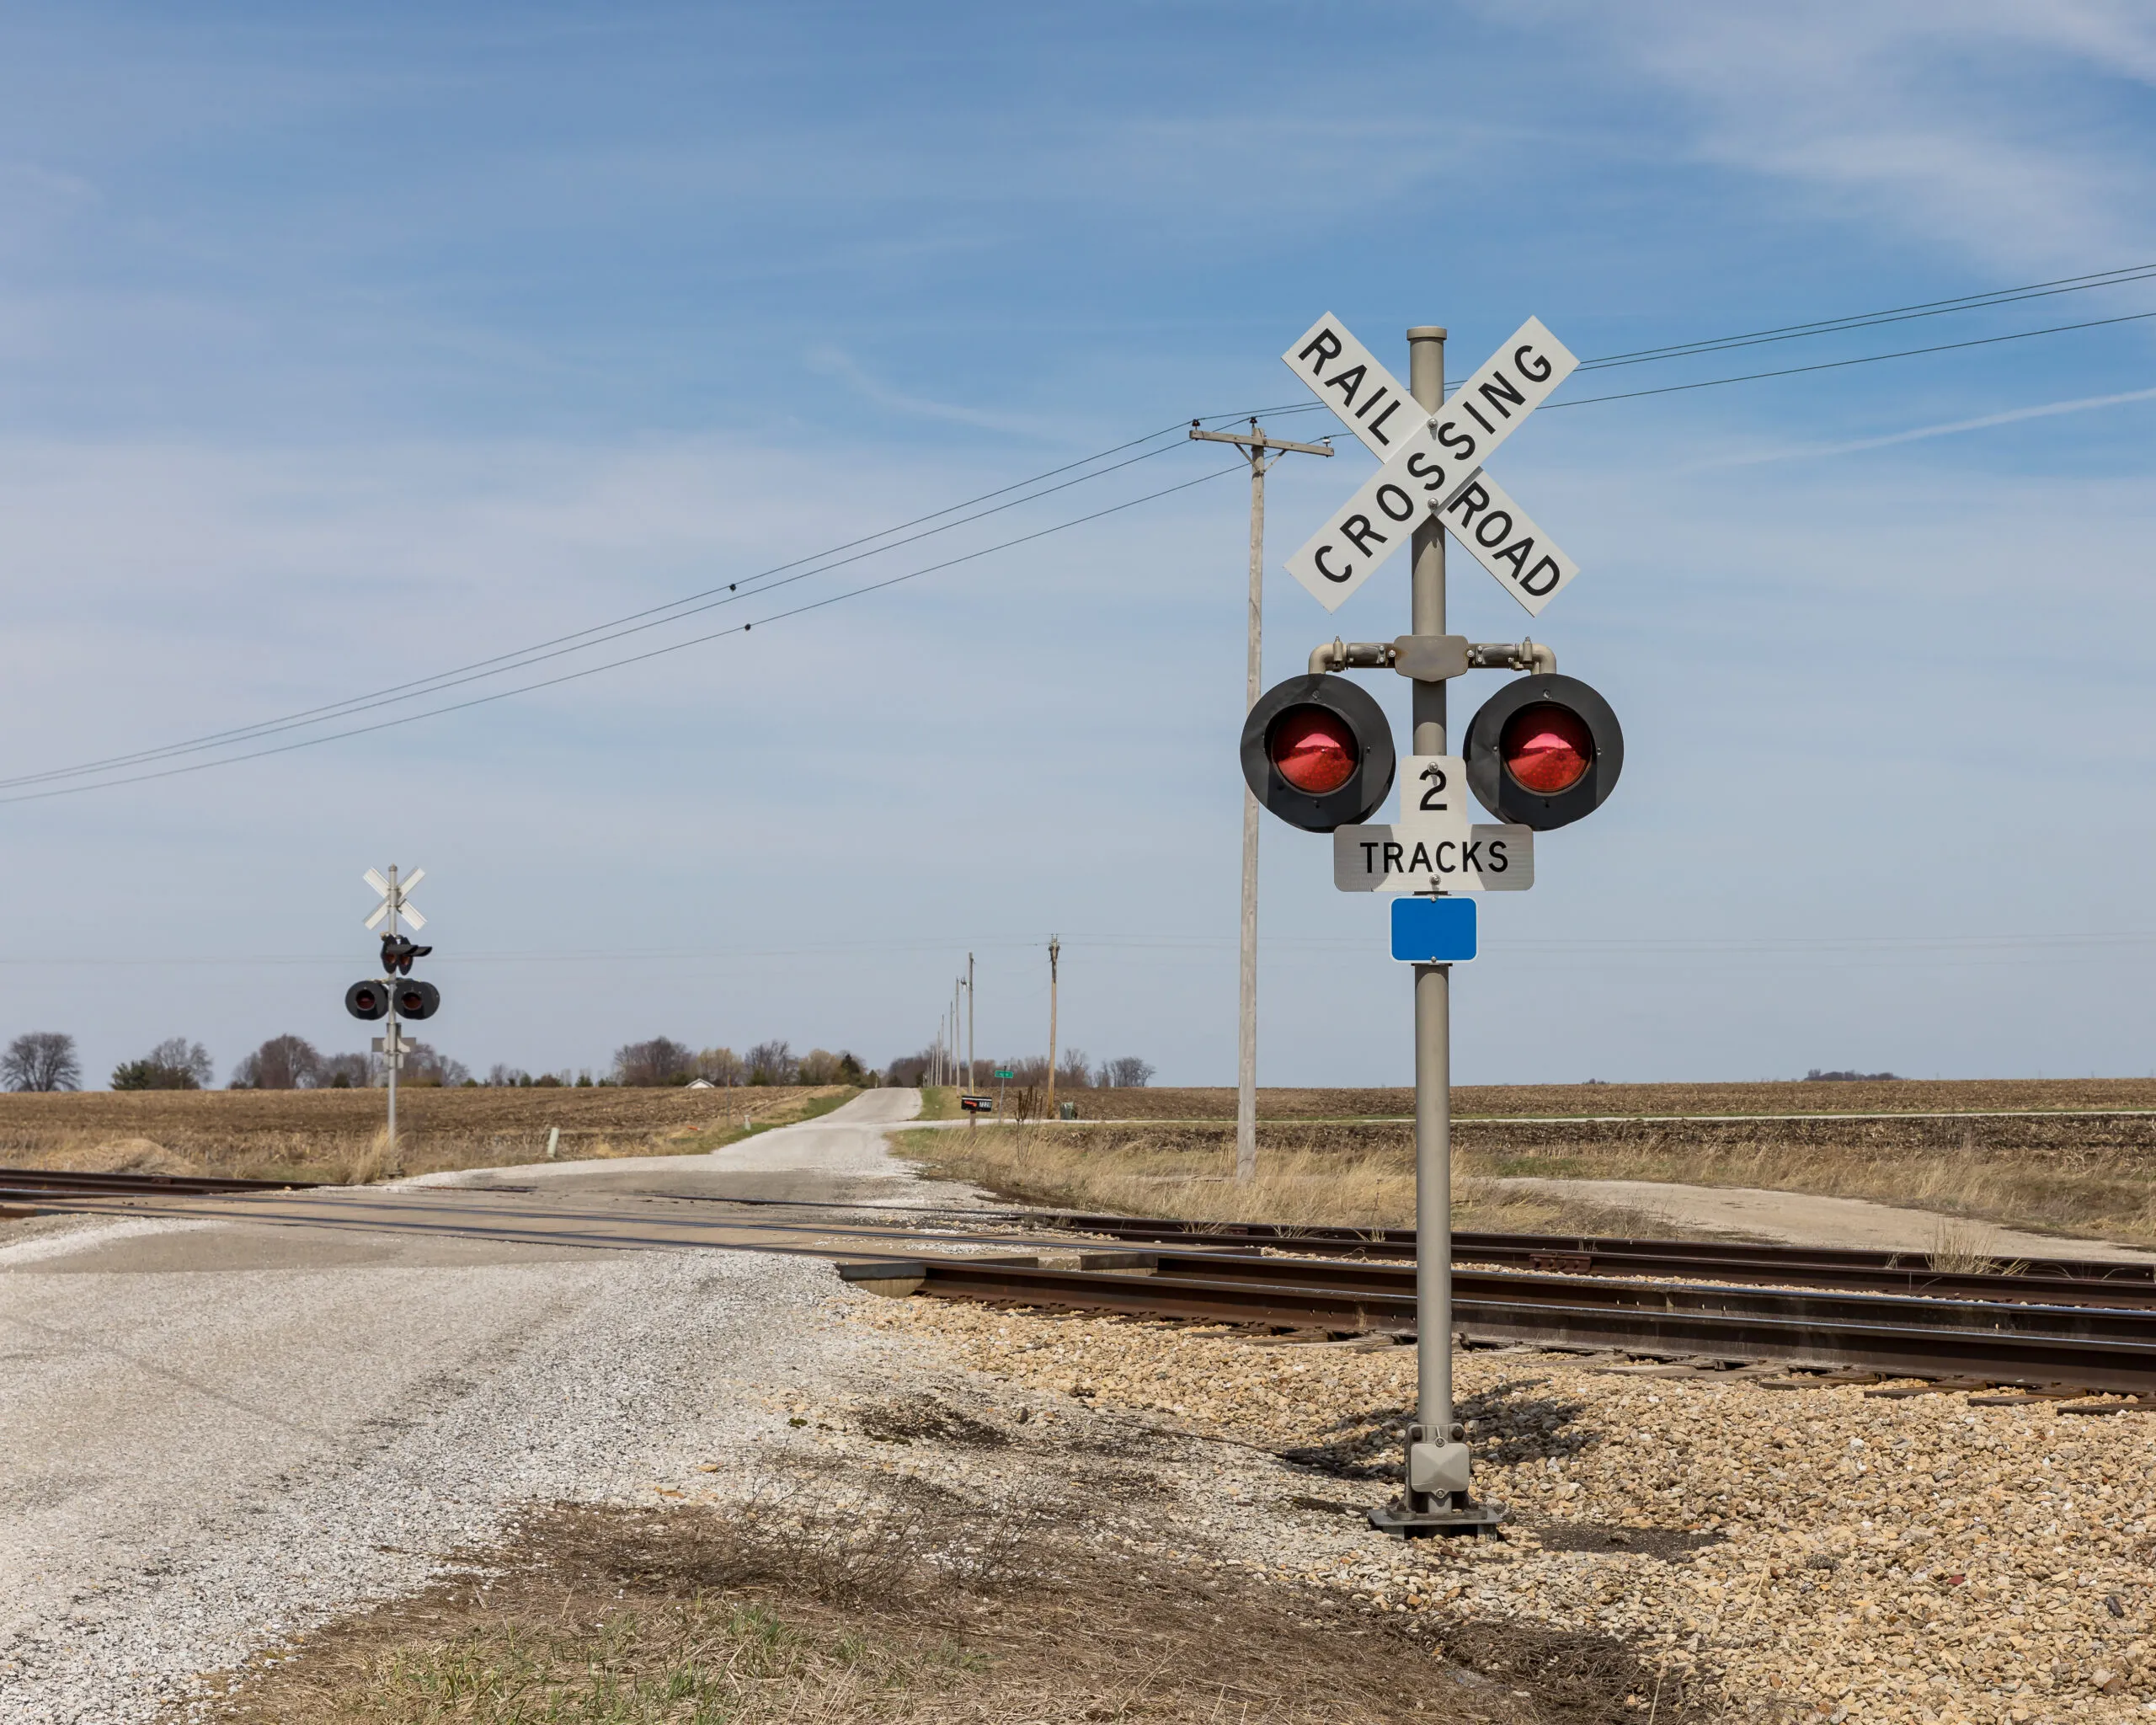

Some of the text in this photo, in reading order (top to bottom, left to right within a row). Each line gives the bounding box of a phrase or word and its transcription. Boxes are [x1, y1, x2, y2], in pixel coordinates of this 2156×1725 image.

[1298, 328, 1561, 596] RAIL ROAD
[1314, 344, 1552, 583] CROSSING
[1359, 841, 1508, 873] TRACKS
[1418, 768, 1448, 811] 2
